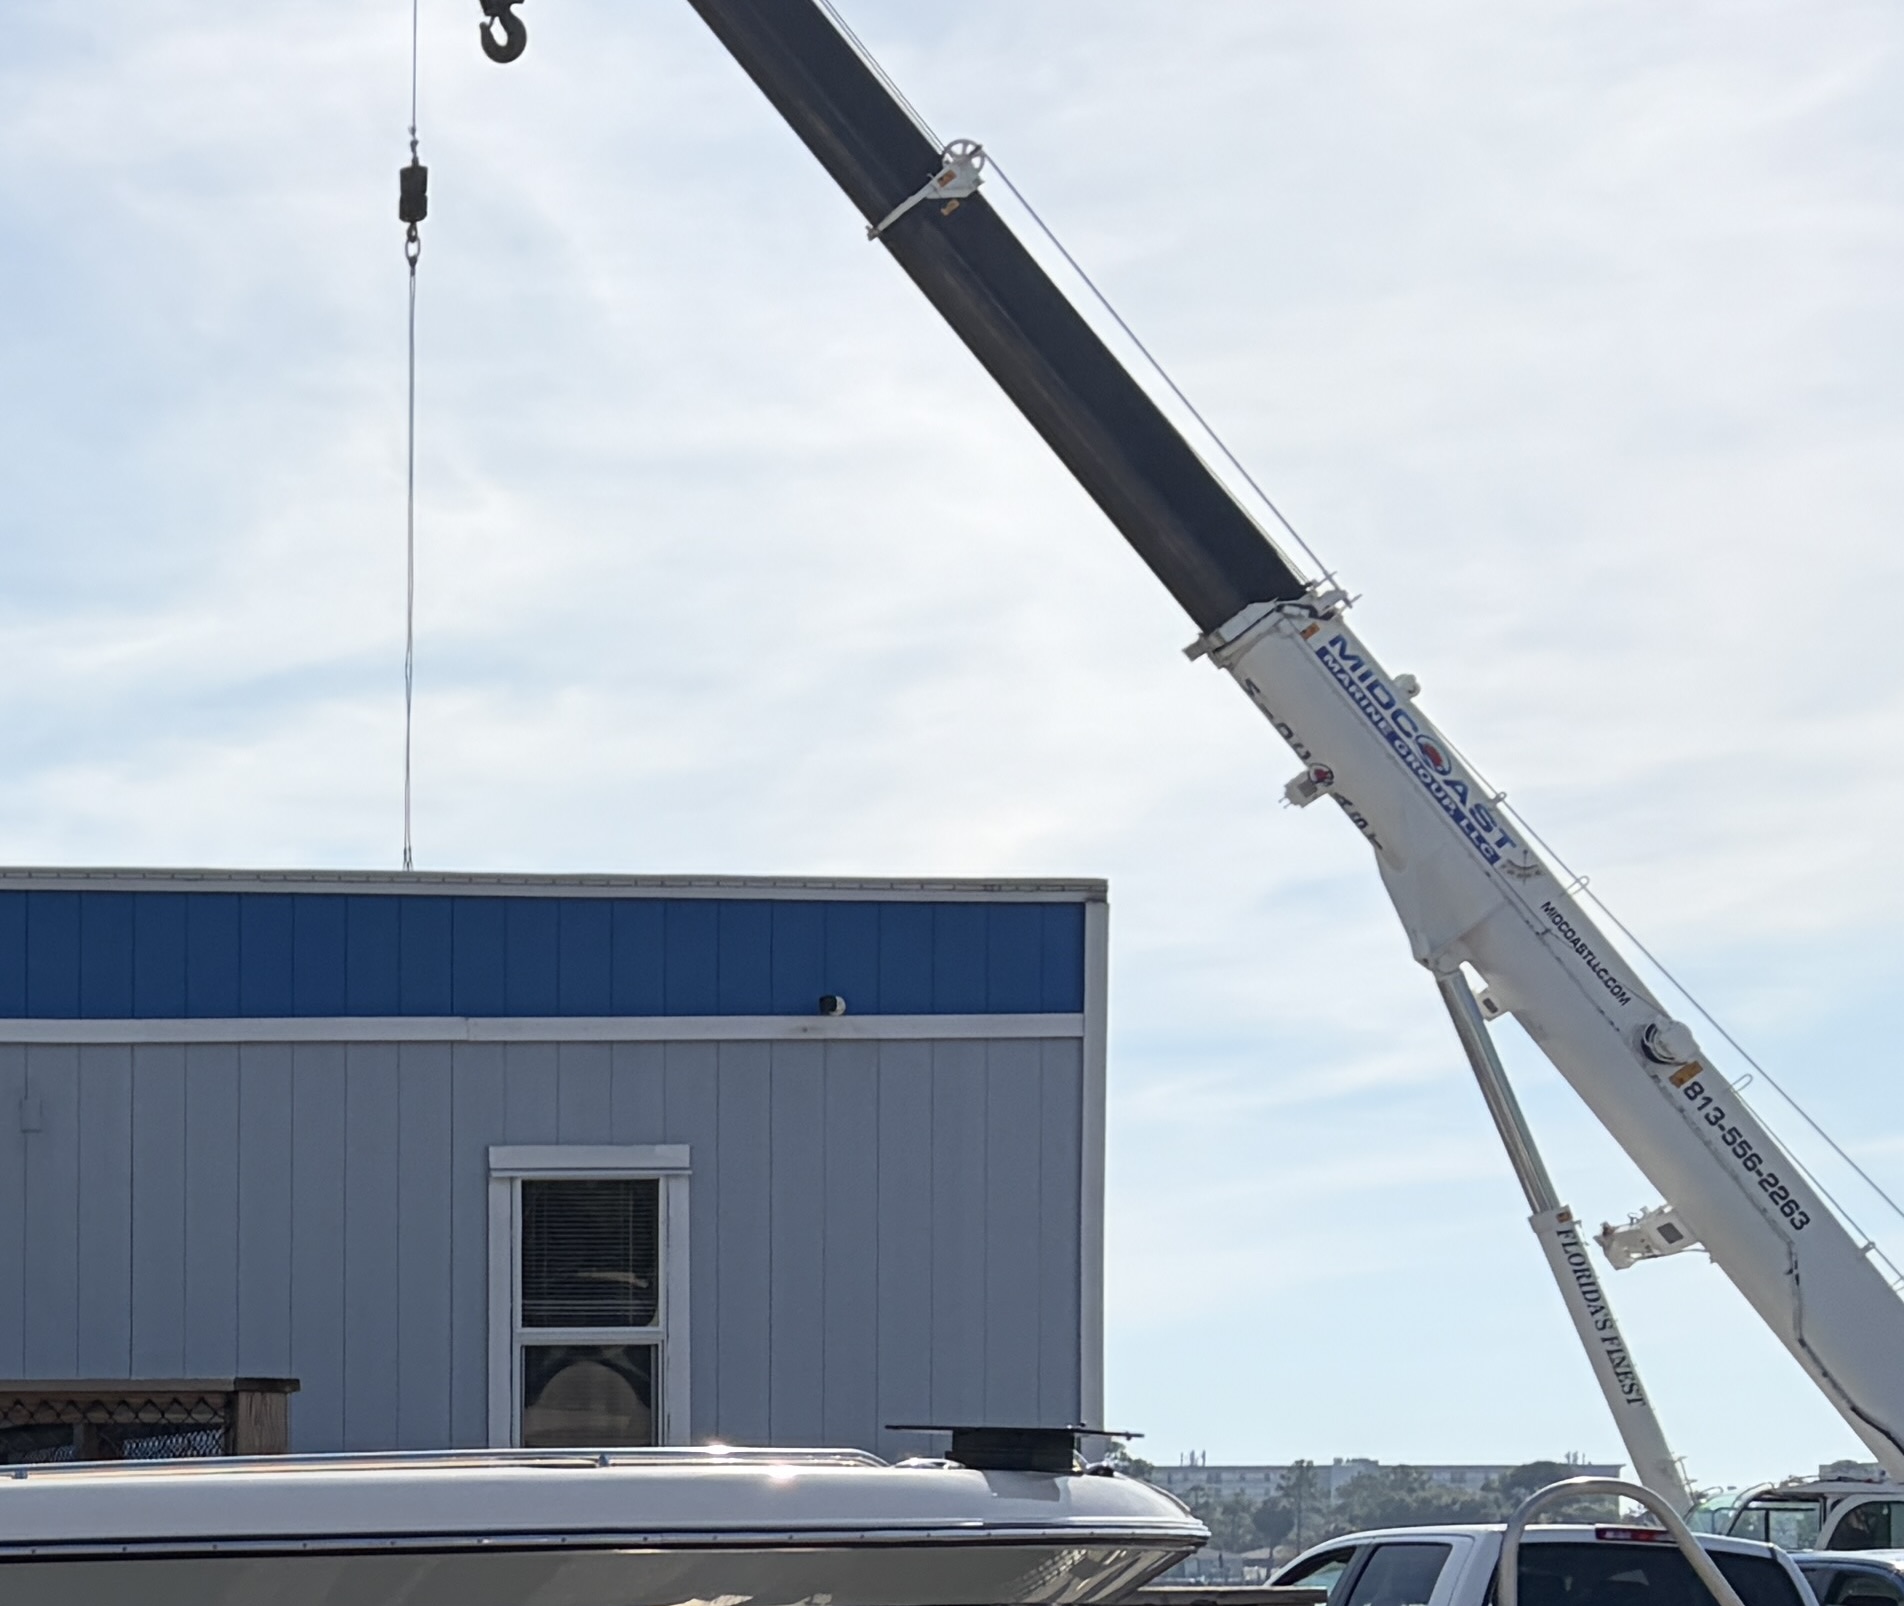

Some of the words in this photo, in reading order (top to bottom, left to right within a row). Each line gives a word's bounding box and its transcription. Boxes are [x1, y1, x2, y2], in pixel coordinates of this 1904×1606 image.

[1323, 653, 1394, 738] MARINE
[1458, 817, 1498, 862] LLC
[1328, 634, 1517, 851] MIDCOAST
[1541, 901, 1631, 1007] MIDCOASTLLC.COM
[1683, 1081, 1811, 1231] 813-556-2263
[1556, 1229, 1614, 1332] FLORIDA'S
[1600, 1335, 1646, 1408] FINEST
